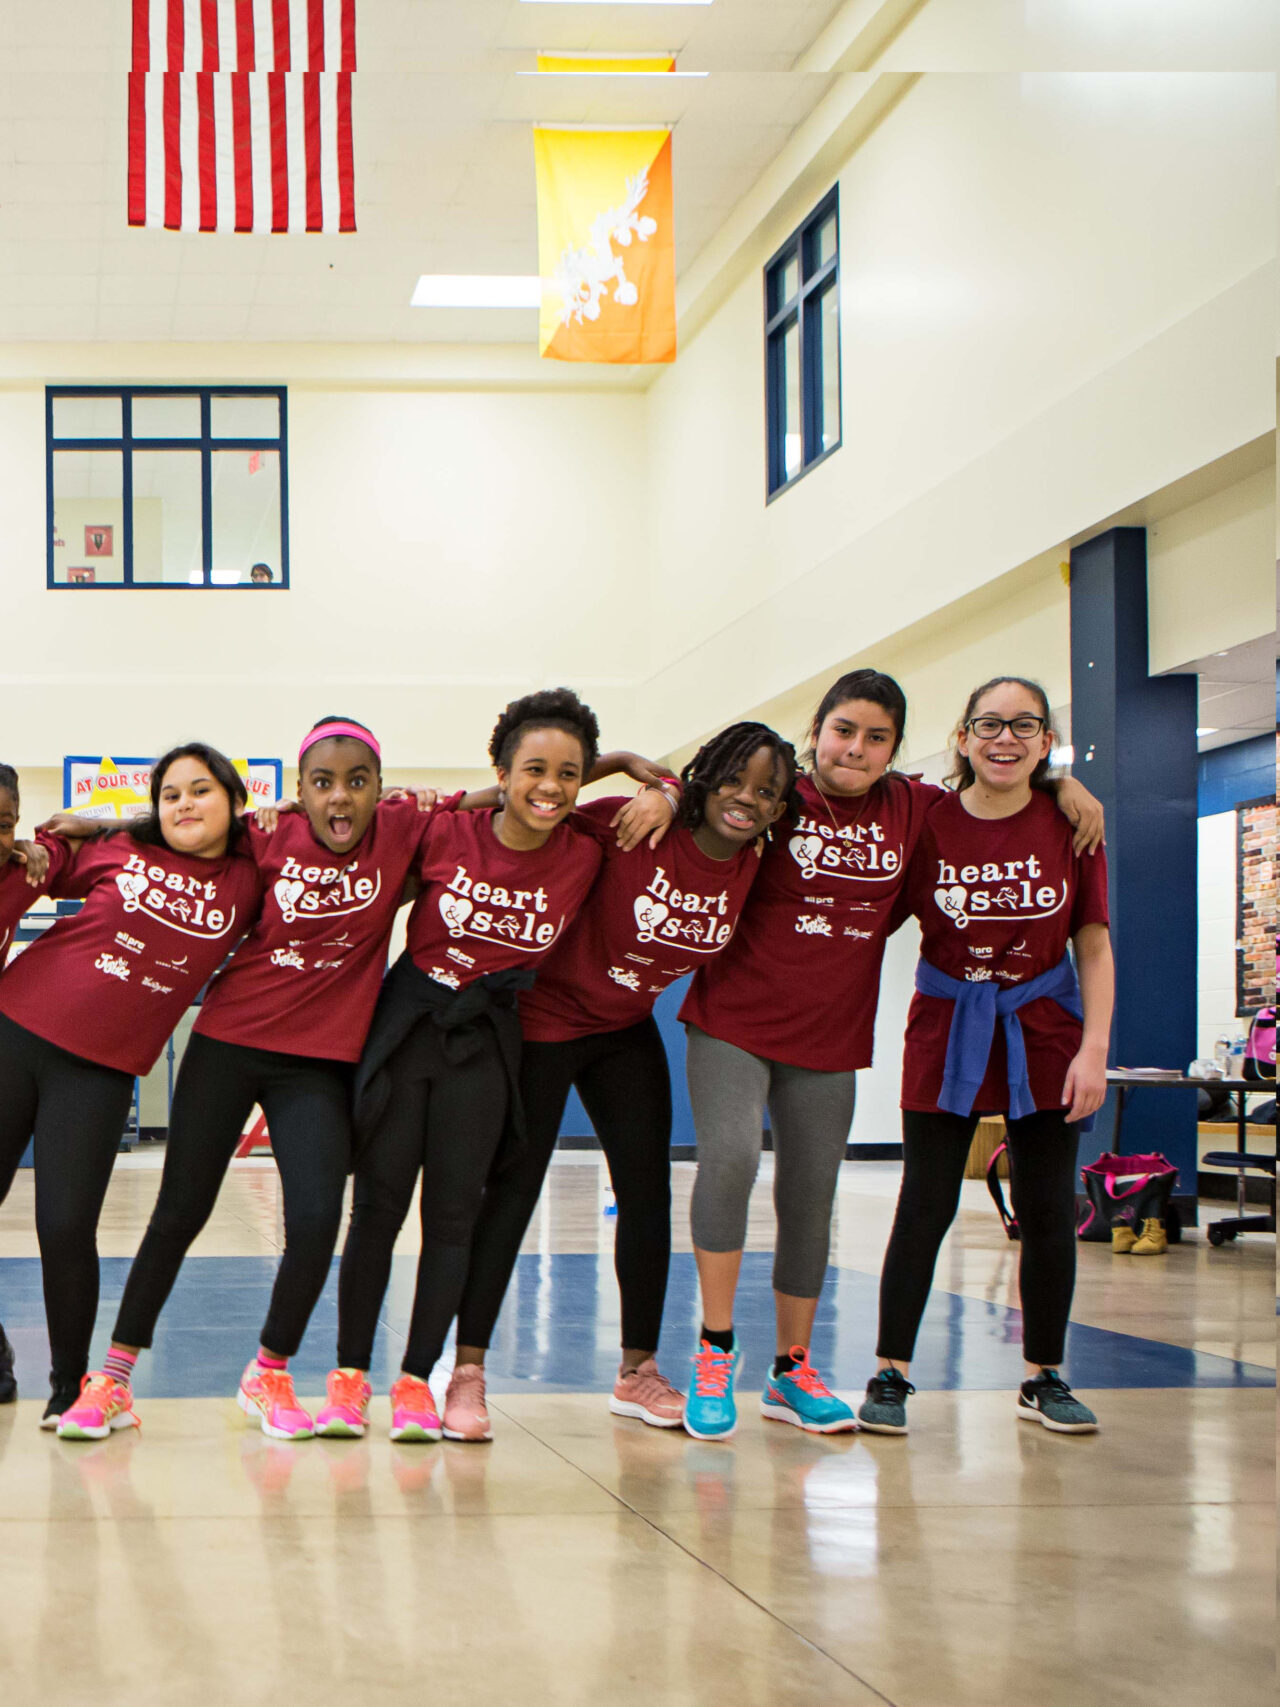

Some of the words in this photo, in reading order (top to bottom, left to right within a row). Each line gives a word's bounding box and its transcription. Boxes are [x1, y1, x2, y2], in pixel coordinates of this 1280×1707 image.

[76, 778, 93, 795] AT
[97, 774, 127, 788] OUR
[246, 779, 270, 796] LUE
[123, 854, 216, 900] heart
[937, 854, 1041, 884] heart
[446, 865, 548, 913] heart
[646, 866, 728, 915] heart
[127, 937, 145, 950] pro
